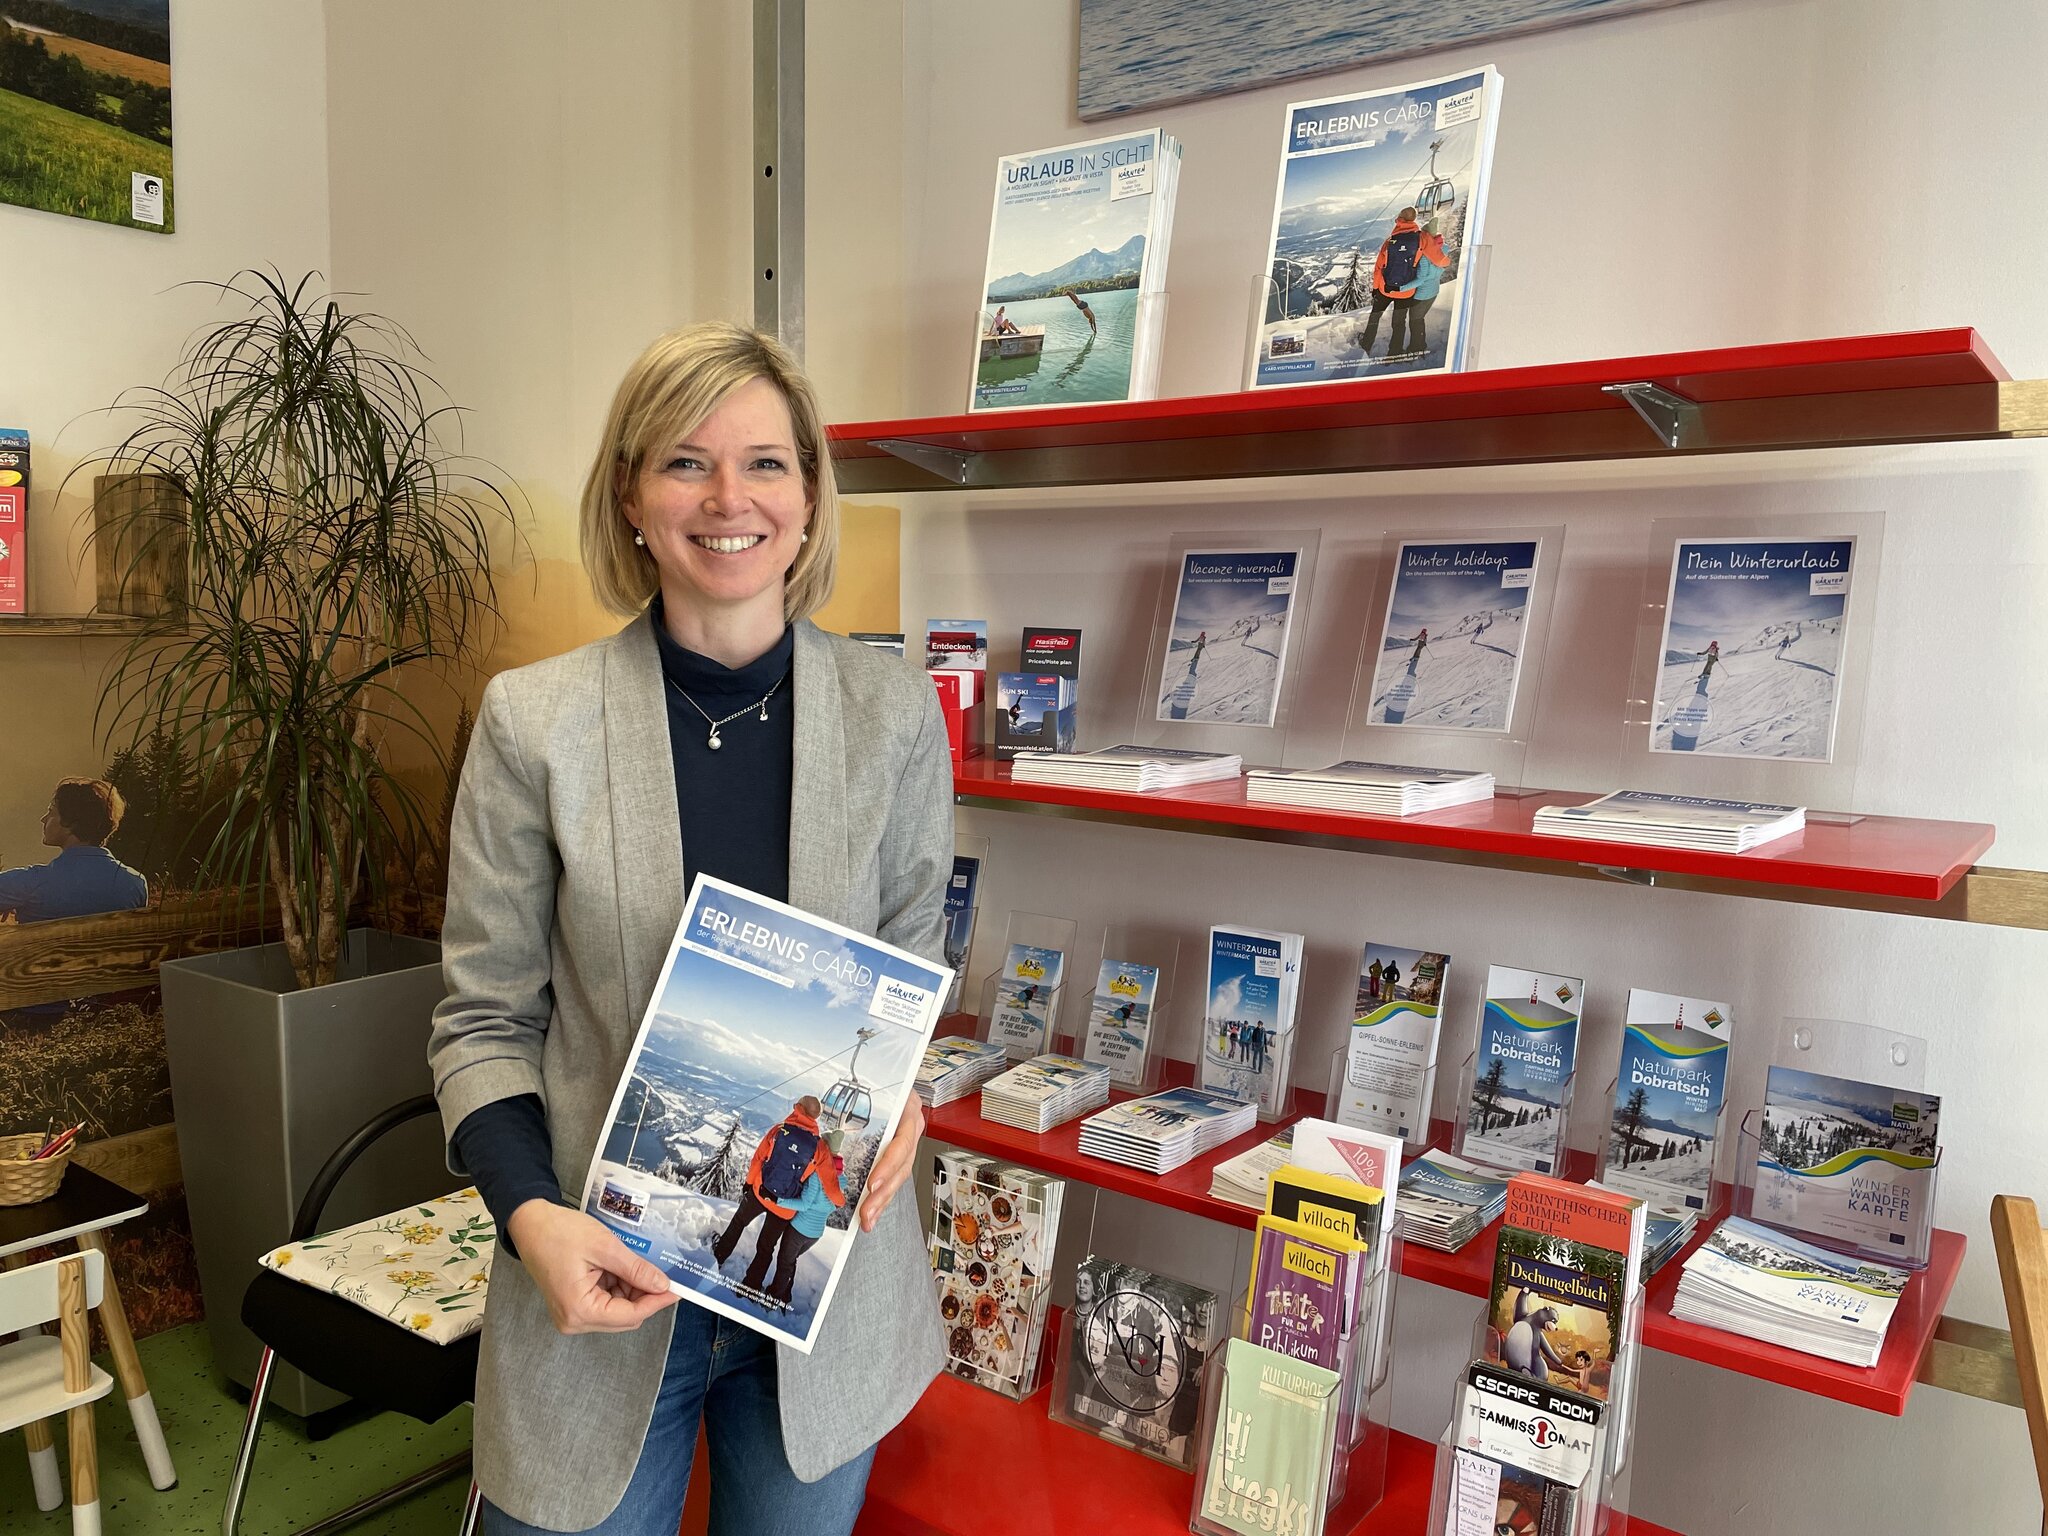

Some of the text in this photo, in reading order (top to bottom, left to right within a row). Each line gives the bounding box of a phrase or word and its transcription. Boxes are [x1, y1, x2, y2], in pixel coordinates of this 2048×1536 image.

[1296, 111, 1380, 139] ERLEBNIS
[1384, 101, 1432, 126] CARD
[1008, 145, 1150, 184] URLAUB IN SICHT
[1011, 182, 1033, 190] HOLIDAY
[1264, 364, 1312, 372] CARD.VISITVILLACH.AT
[1190, 559, 1284, 575] Vacanze invernali
[1408, 550, 1509, 572] Winter holidays
[1687, 550, 1840, 569] Mein Winterurlaub
[931, 642, 974, 650] Entdecken.
[998, 744, 1054, 752] www.nassfeld.at/en
[696, 928, 710, 938] der
[710, 933, 736, 948] Region
[699, 906, 872, 987] ERLEBNIS CARD
[1216, 940, 1278, 957] WINTERZAUBER
[1216, 950, 1251, 960] WINTERMAGIC
[905, 1010, 916, 1019] Alpe
[1010, 1014, 1021, 1022] BEST
[1014, 1023, 1030, 1032] HEART
[1103, 1032, 1122, 1042] BESTEN
[1106, 1042, 1131, 1052] ZENTRUM
[1492, 1029, 1563, 1056] Naturpark
[1491, 1042, 1561, 1068] Dobratsch
[1632, 1056, 1712, 1084] Naturpark
[1631, 1070, 1710, 1098] Dobratsch
[1686, 1096, 1708, 1104] WINTER
[1352, 1146, 1378, 1178] 10%
[1851, 1176, 1911, 1198] WINTER
[1512, 1186, 1628, 1226] CARINTHISCHER
[1849, 1188, 1910, 1211] WANDER
[1303, 1210, 1350, 1234] villach
[1509, 1213, 1520, 1226] 6.
[1510, 1200, 1571, 1225] SOMMER
[1848, 1200, 1909, 1222] KARTE
[1288, 1251, 1330, 1278] villach
[1510, 1261, 1608, 1304] Dschungelbuch
[1262, 1364, 1325, 1397] KULTURHOF
[1475, 1374, 1594, 1423] ESCAPE ROOM
